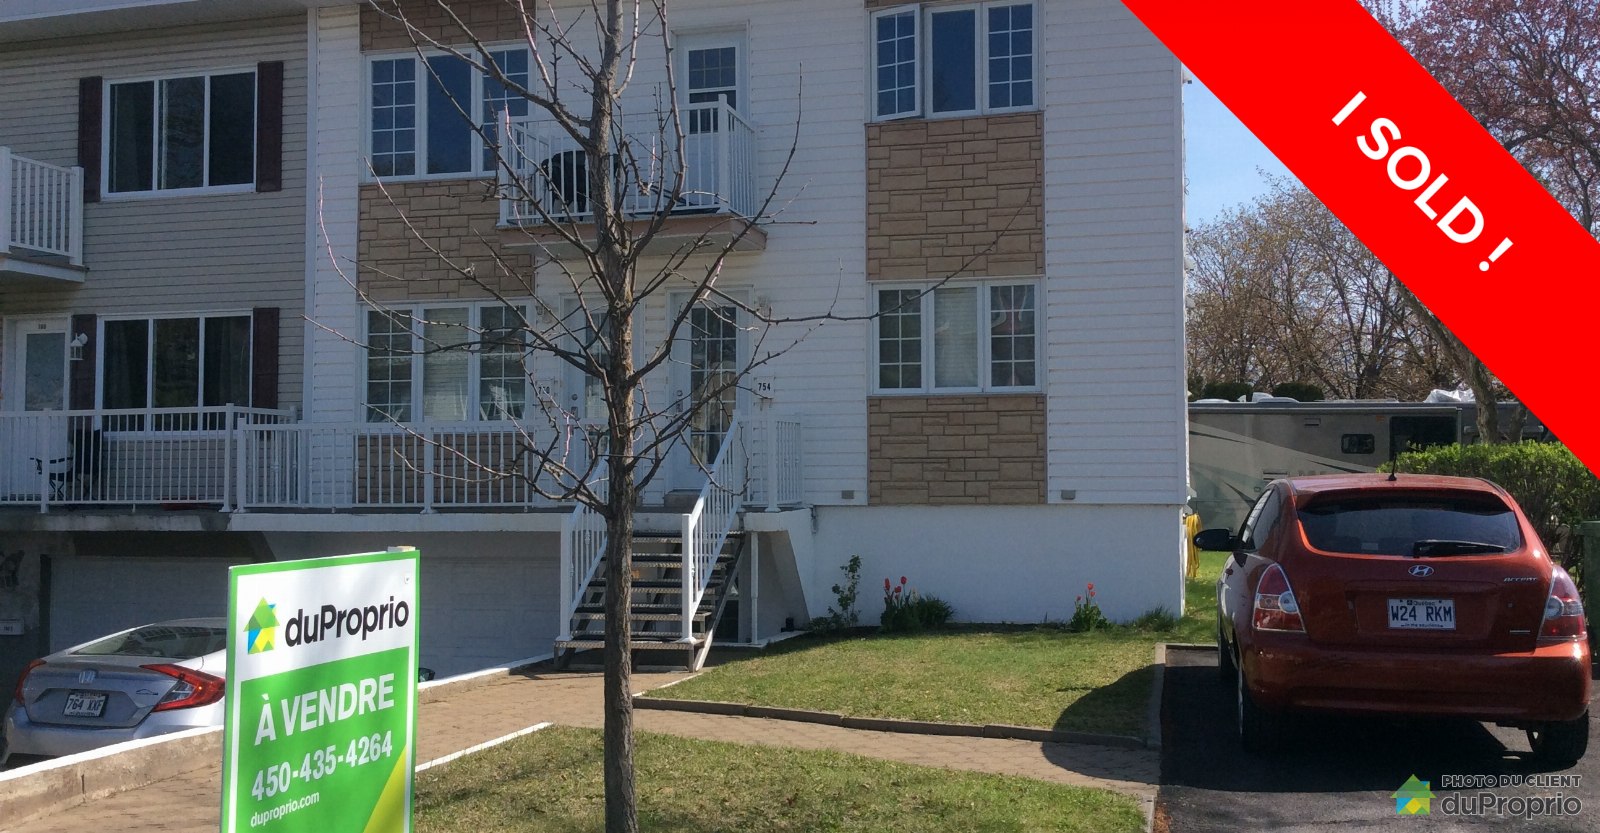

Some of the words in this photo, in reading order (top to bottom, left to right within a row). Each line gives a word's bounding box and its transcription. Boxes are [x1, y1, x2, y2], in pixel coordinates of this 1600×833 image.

[758, 382, 771, 391] 754
[285, 596, 409, 647] duProprio
[1391, 606, 1417, 621] W24
[1426, 606, 1453, 622] RKM
[67, 698, 84, 710] 764
[254, 693, 277, 746] À
[281, 673, 395, 736] VENDRE
[251, 730, 393, 801] 450-435-4264
[250, 791, 320, 828] duproprio.com
